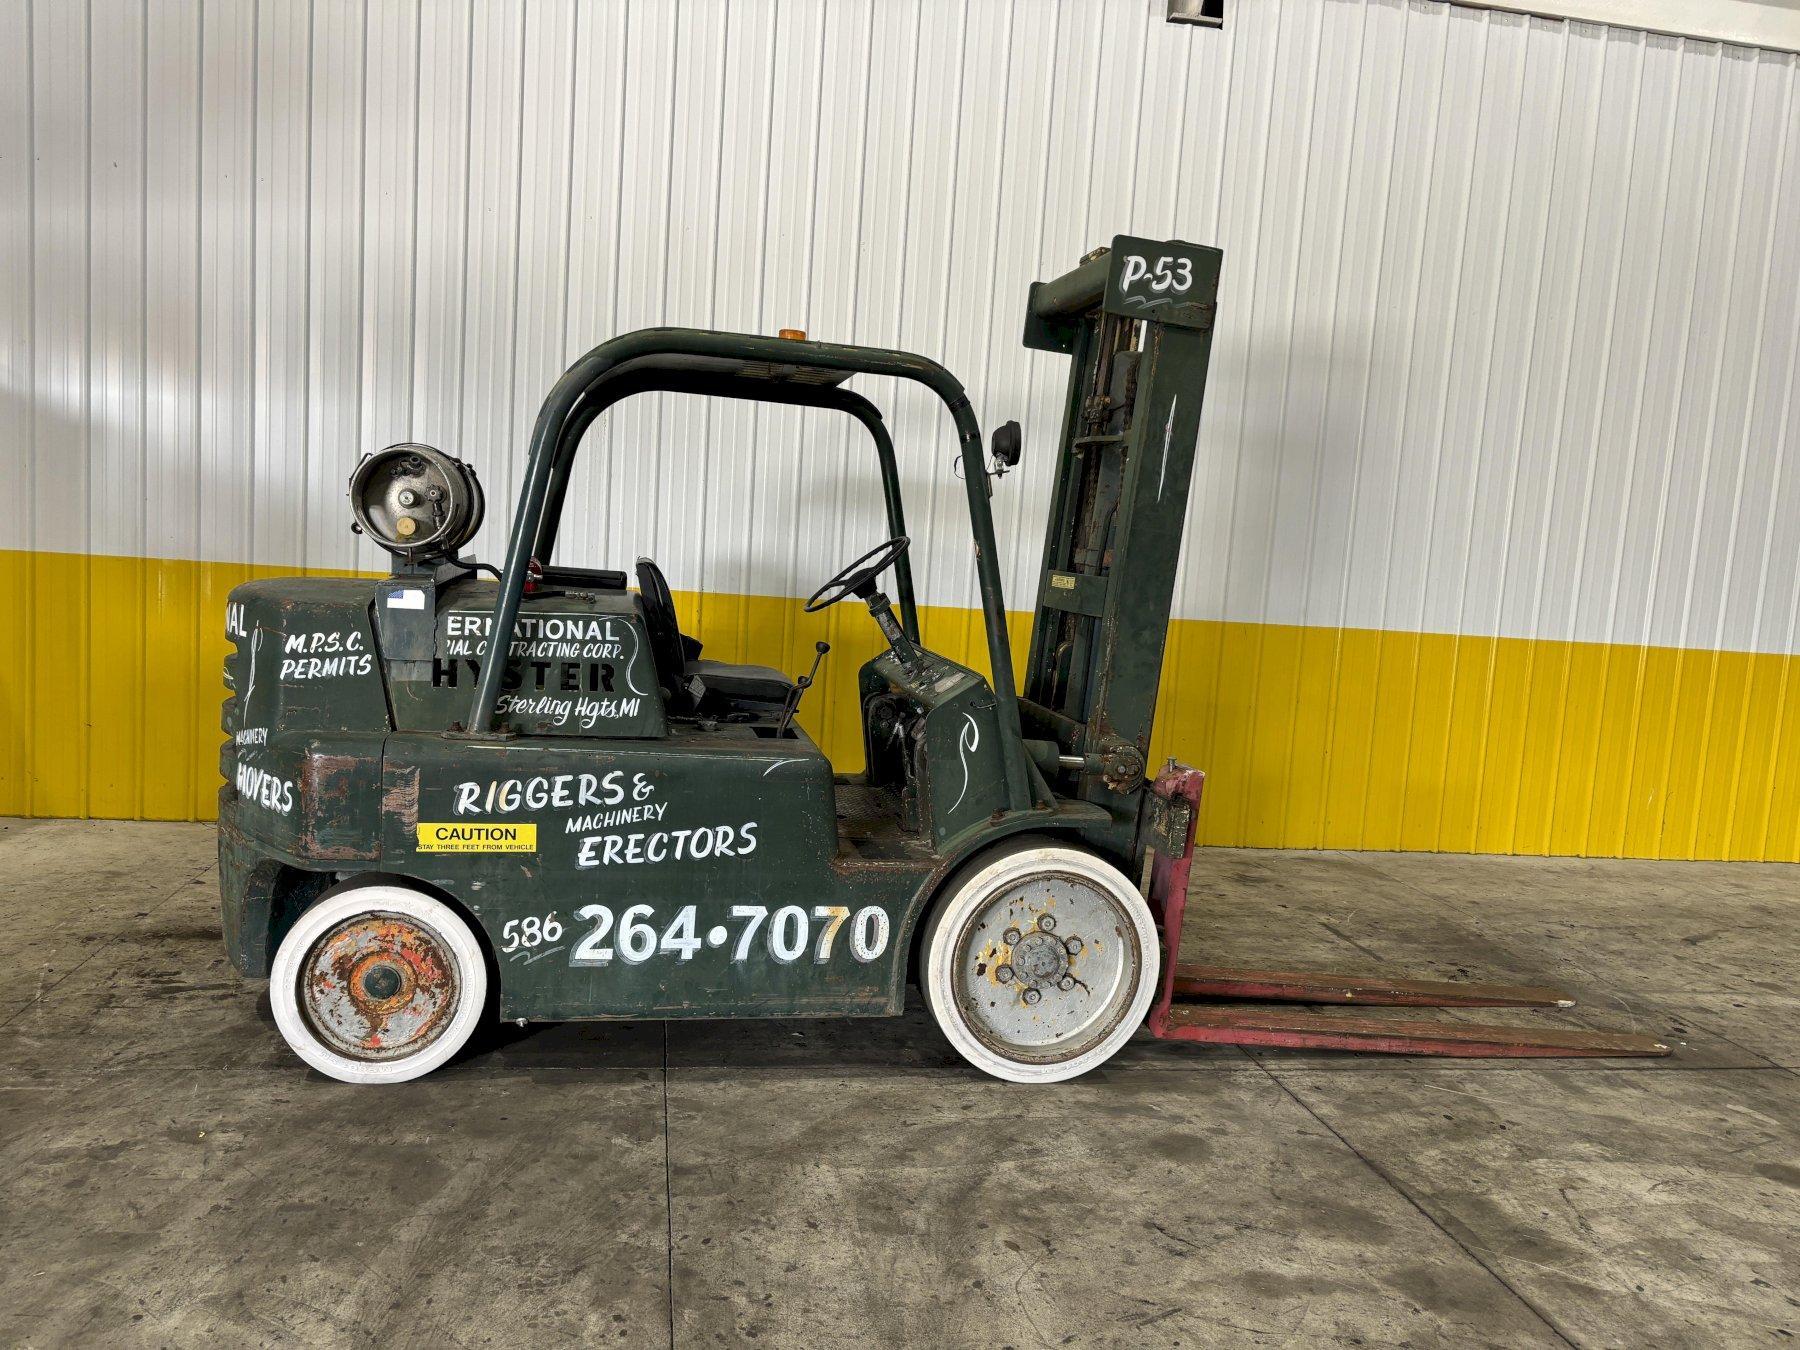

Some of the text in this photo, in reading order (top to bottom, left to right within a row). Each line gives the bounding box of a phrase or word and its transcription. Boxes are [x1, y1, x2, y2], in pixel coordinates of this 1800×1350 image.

[1120, 255, 1193, 293] P-53
[284, 631, 364, 654] M.P.S.C.
[447, 616, 620, 641] ERTIONAL
[447, 639, 625, 660] IAL CTRACTING CORP.
[279, 654, 373, 680] PERMITS
[495, 694, 572, 726] Sterling
[236, 762, 293, 814] MOVERS
[454, 770, 655, 816] RIGGERS &
[435, 827, 517, 841] CAUTION
[564, 802, 669, 834] MACHINERY
[576, 822, 759, 870] ERECTORS
[500, 910, 563, 953] 586
